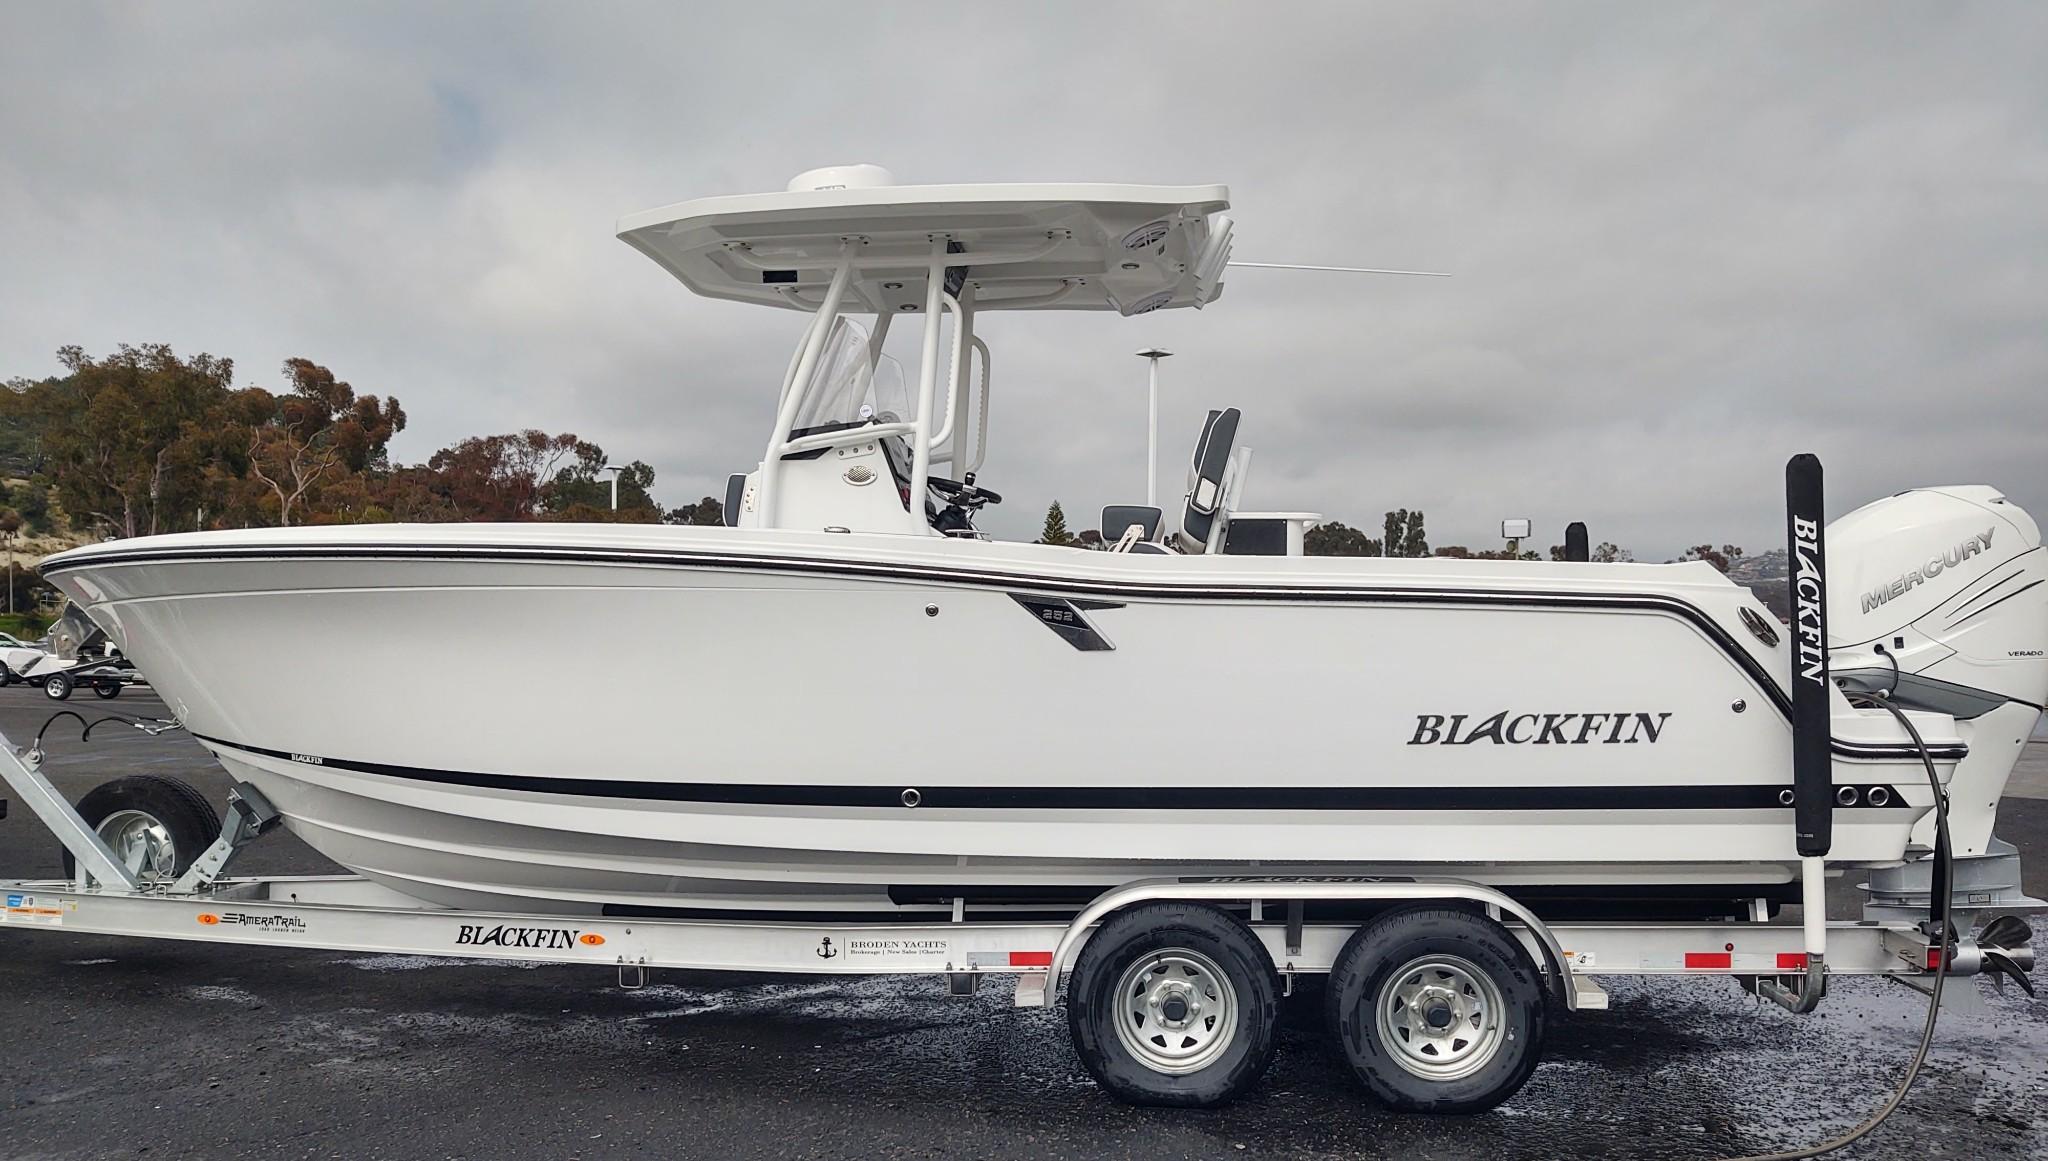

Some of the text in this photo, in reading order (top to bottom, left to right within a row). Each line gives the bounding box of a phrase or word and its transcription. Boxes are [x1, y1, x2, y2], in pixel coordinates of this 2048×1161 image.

[1860, 526, 1995, 614] MERCURY
[1794, 515, 1824, 687] BLACKFIN
[1407, 710, 1673, 745] BLACKFIN
[291, 753, 323, 765] BLACKFIN
[456, 925, 580, 949] BLACKFIN
[851, 940, 947, 948] BRODEN YACHTS
